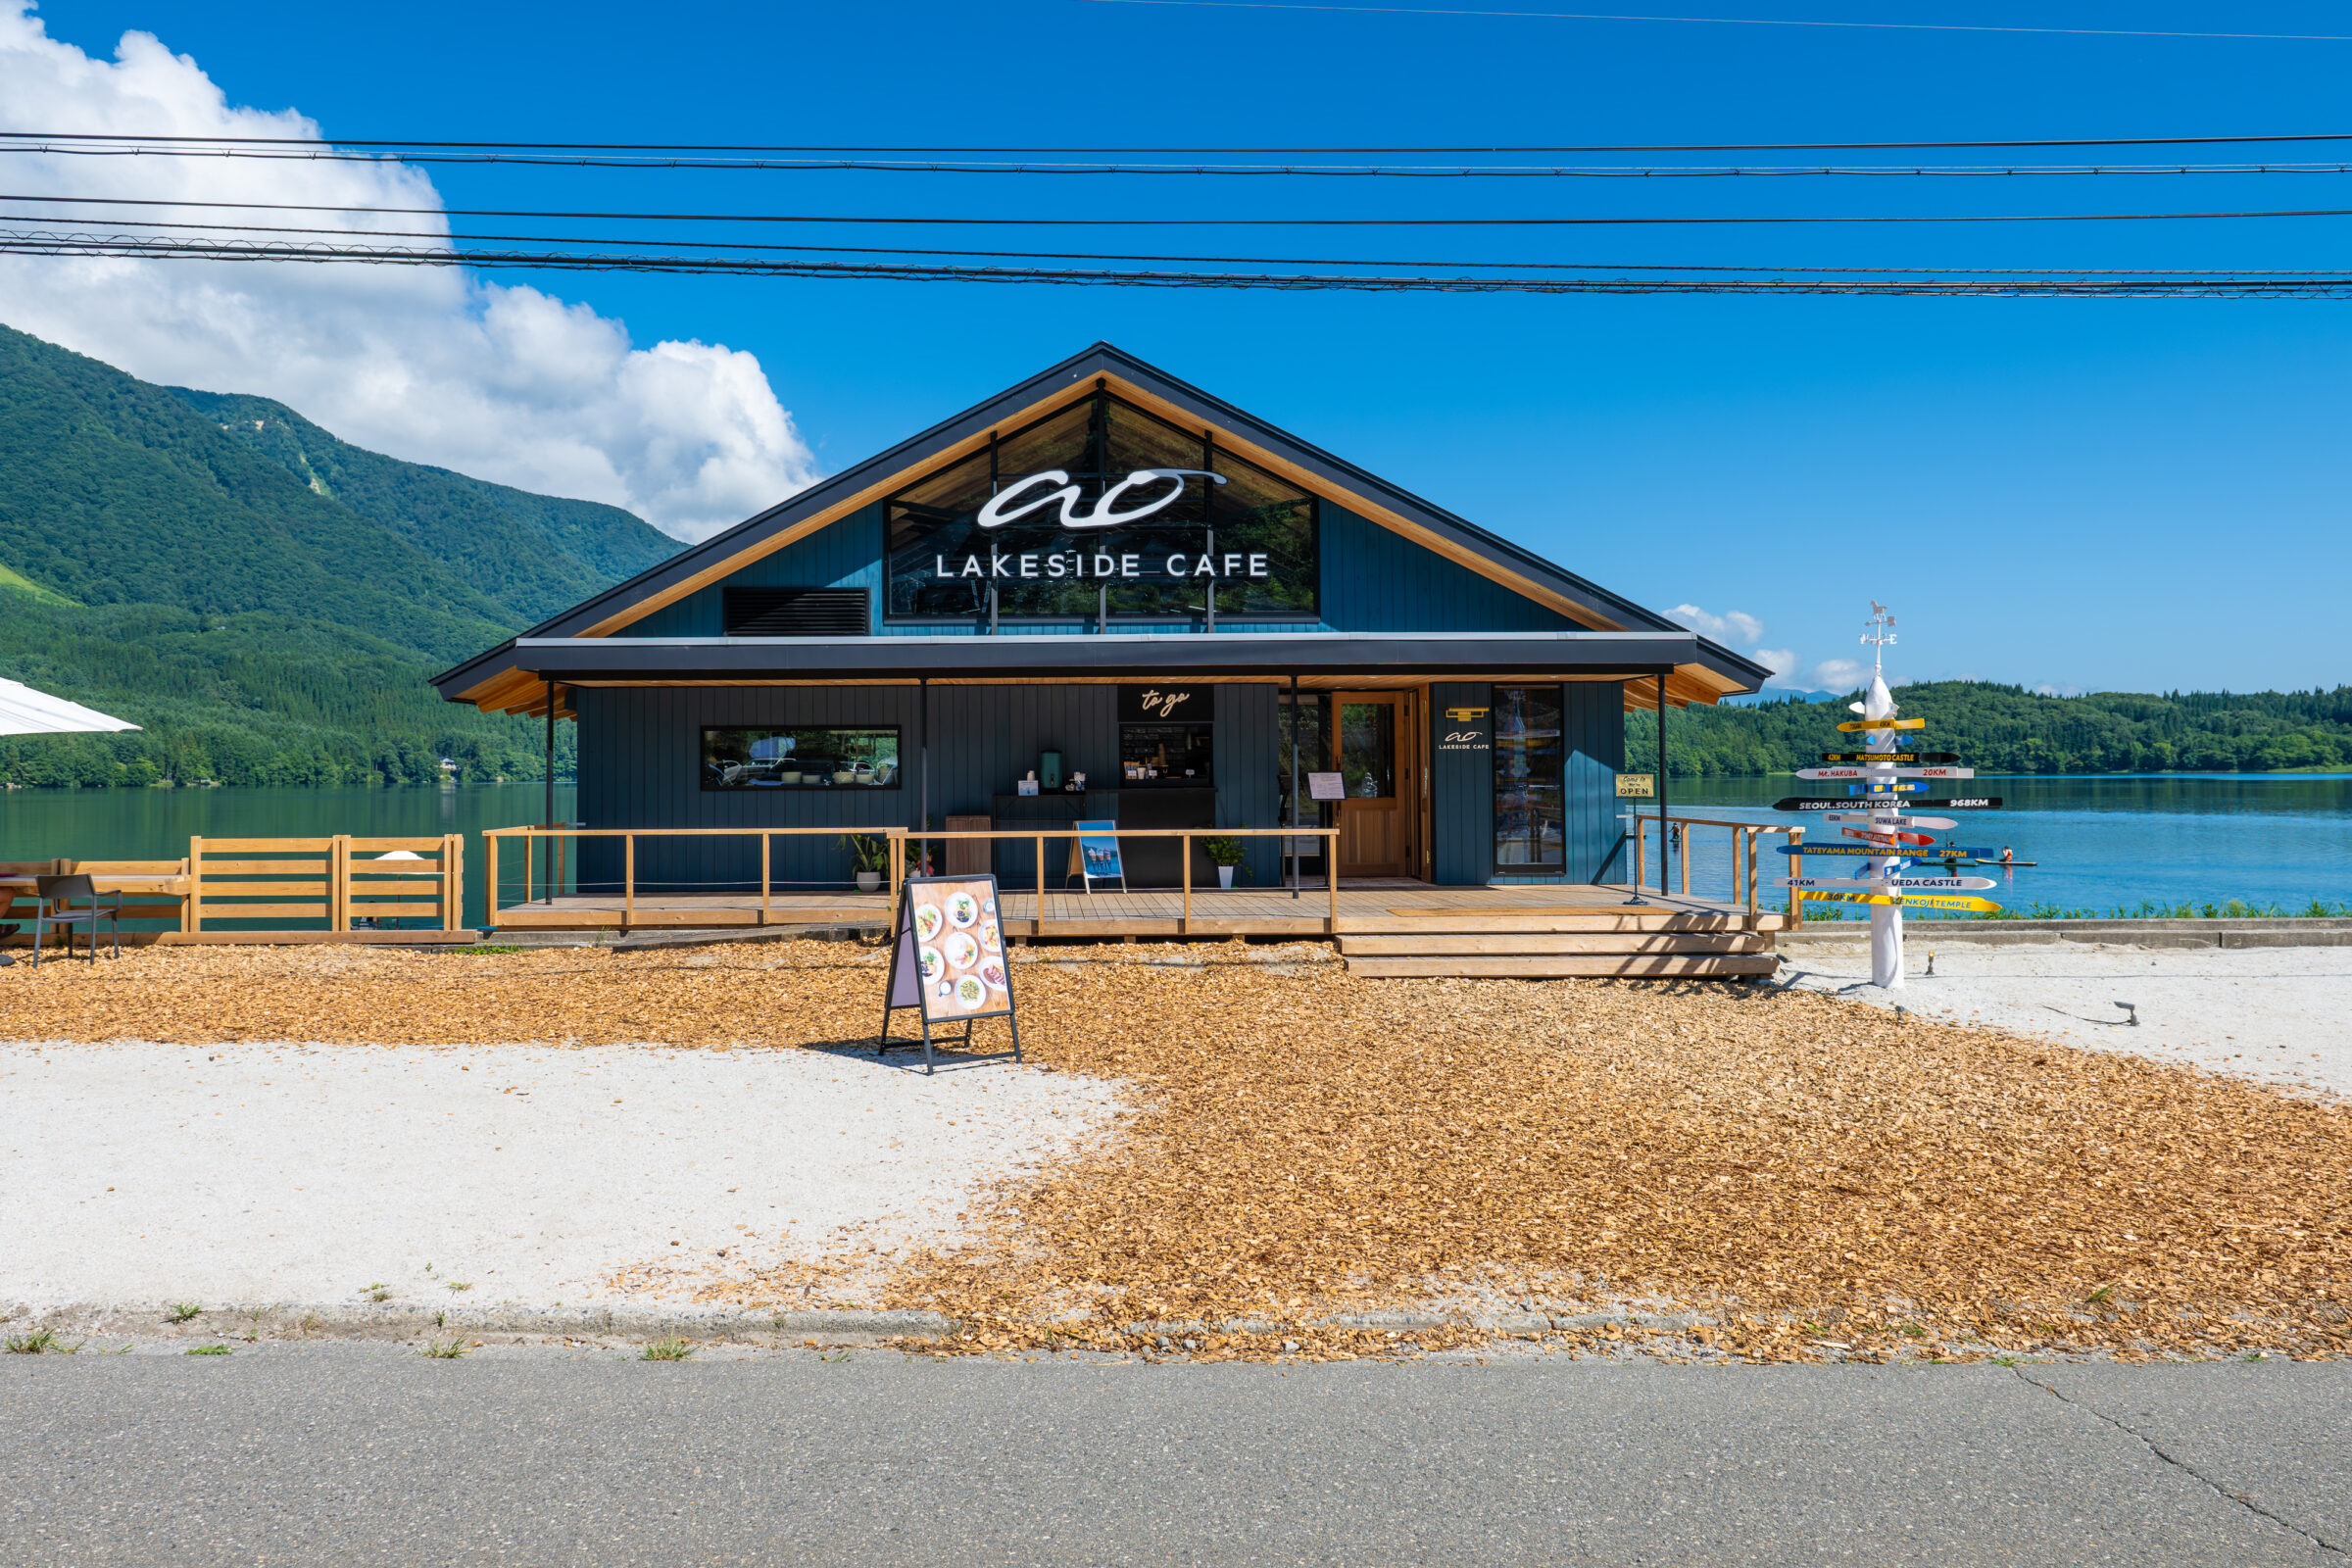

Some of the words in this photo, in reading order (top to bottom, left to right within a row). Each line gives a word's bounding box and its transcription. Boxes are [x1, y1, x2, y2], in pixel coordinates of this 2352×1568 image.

[937, 554, 1141, 577] LAKESIDE
[1166, 554, 1269, 577] CAFE
[1142, 689, 1162, 710] to
[1160, 692, 1190, 717] go
[1892, 897, 1933, 906] ZENKOJI
[1935, 900, 1971, 908] TEMPLE
